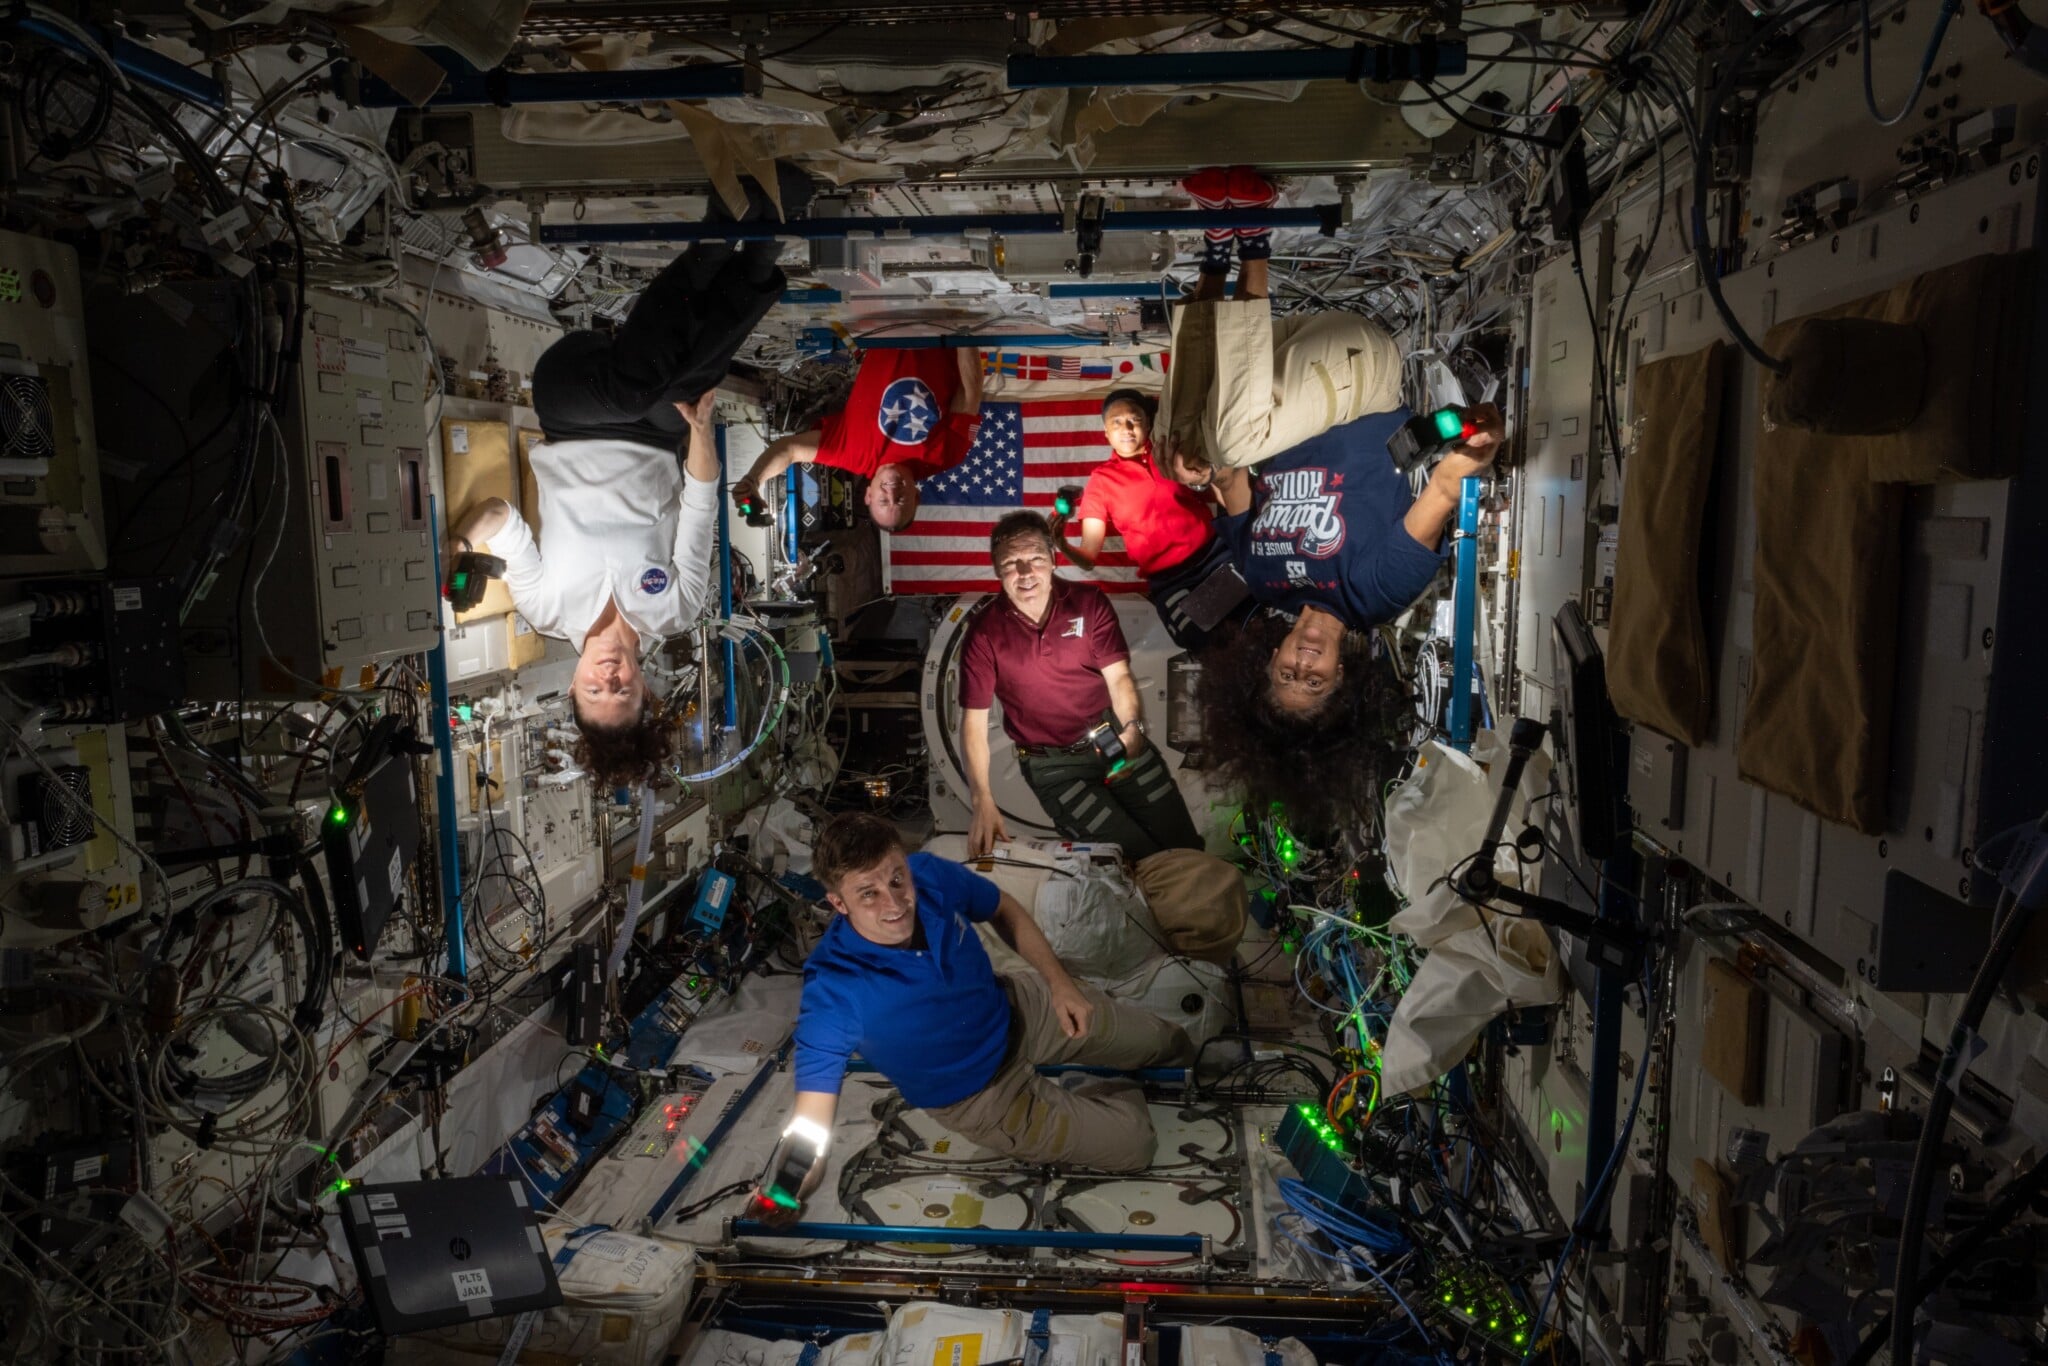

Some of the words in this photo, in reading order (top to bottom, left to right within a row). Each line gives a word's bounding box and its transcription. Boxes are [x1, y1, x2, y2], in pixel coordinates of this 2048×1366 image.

[1264, 471, 1323, 499] HOUSE
[1256, 541, 1264, 555] IS
[1265, 541, 1295, 556] HOUSE
[1285, 560, 1308, 579] ISS
[458, 1273, 482, 1284] PLT5
[461, 1285, 487, 1297] JAXA
